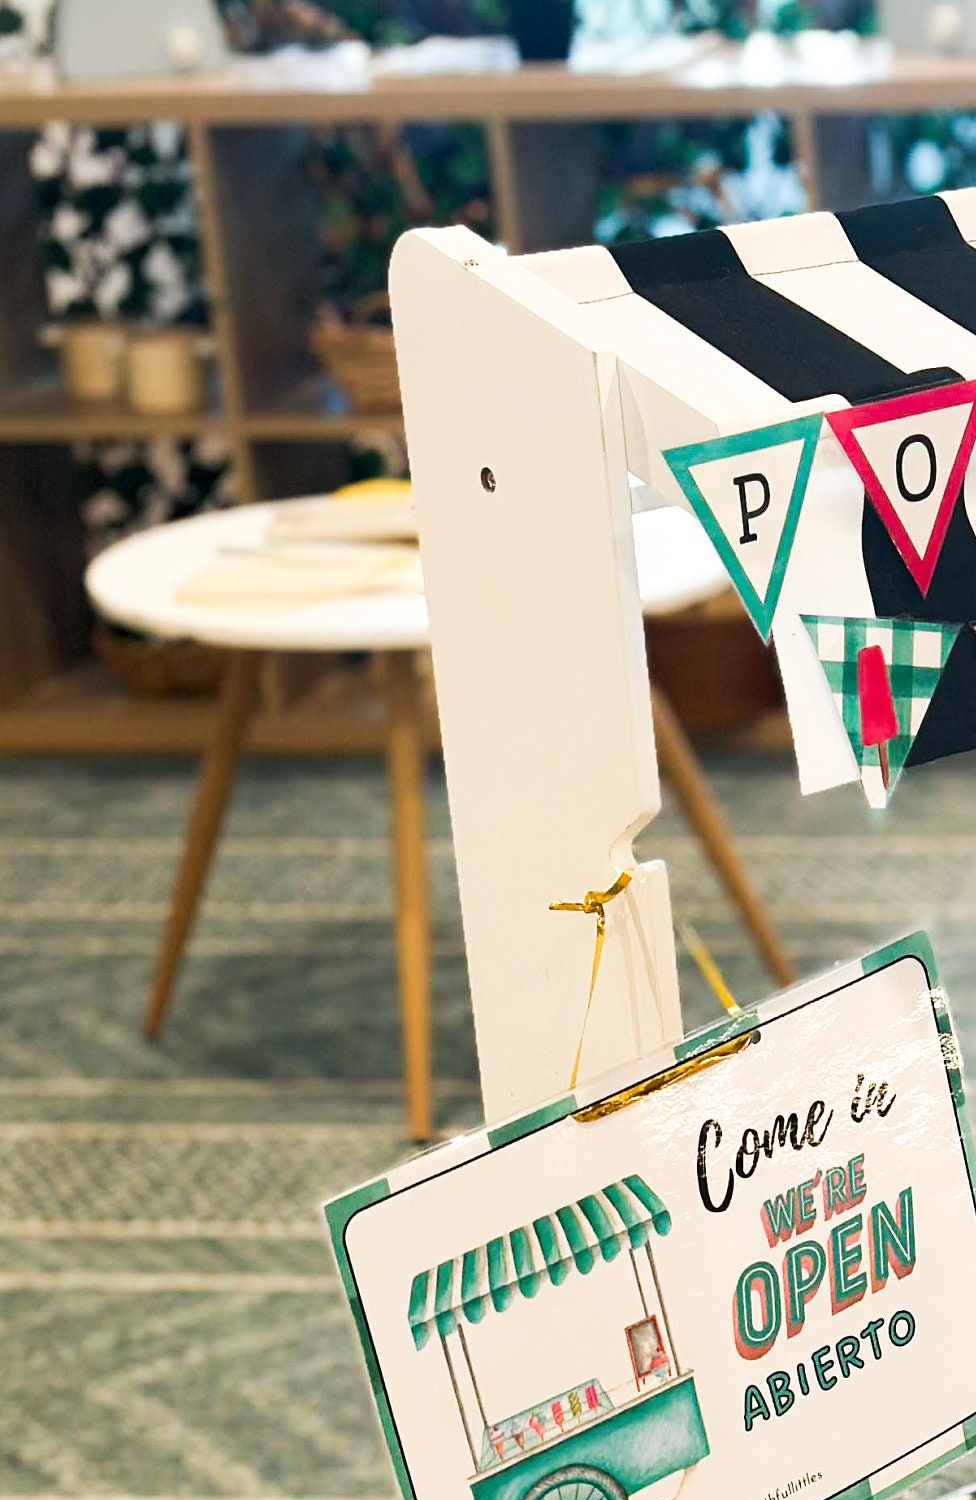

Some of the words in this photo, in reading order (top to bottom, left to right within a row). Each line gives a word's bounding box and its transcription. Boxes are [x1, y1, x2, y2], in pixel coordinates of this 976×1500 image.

[695, 1099, 835, 1214] Come
[850, 1073, 897, 1124] in
[759, 1152, 868, 1250] WE'RE
[731, 1185, 917, 1361] OPEN
[743, 1309, 916, 1432] ABIERTO
